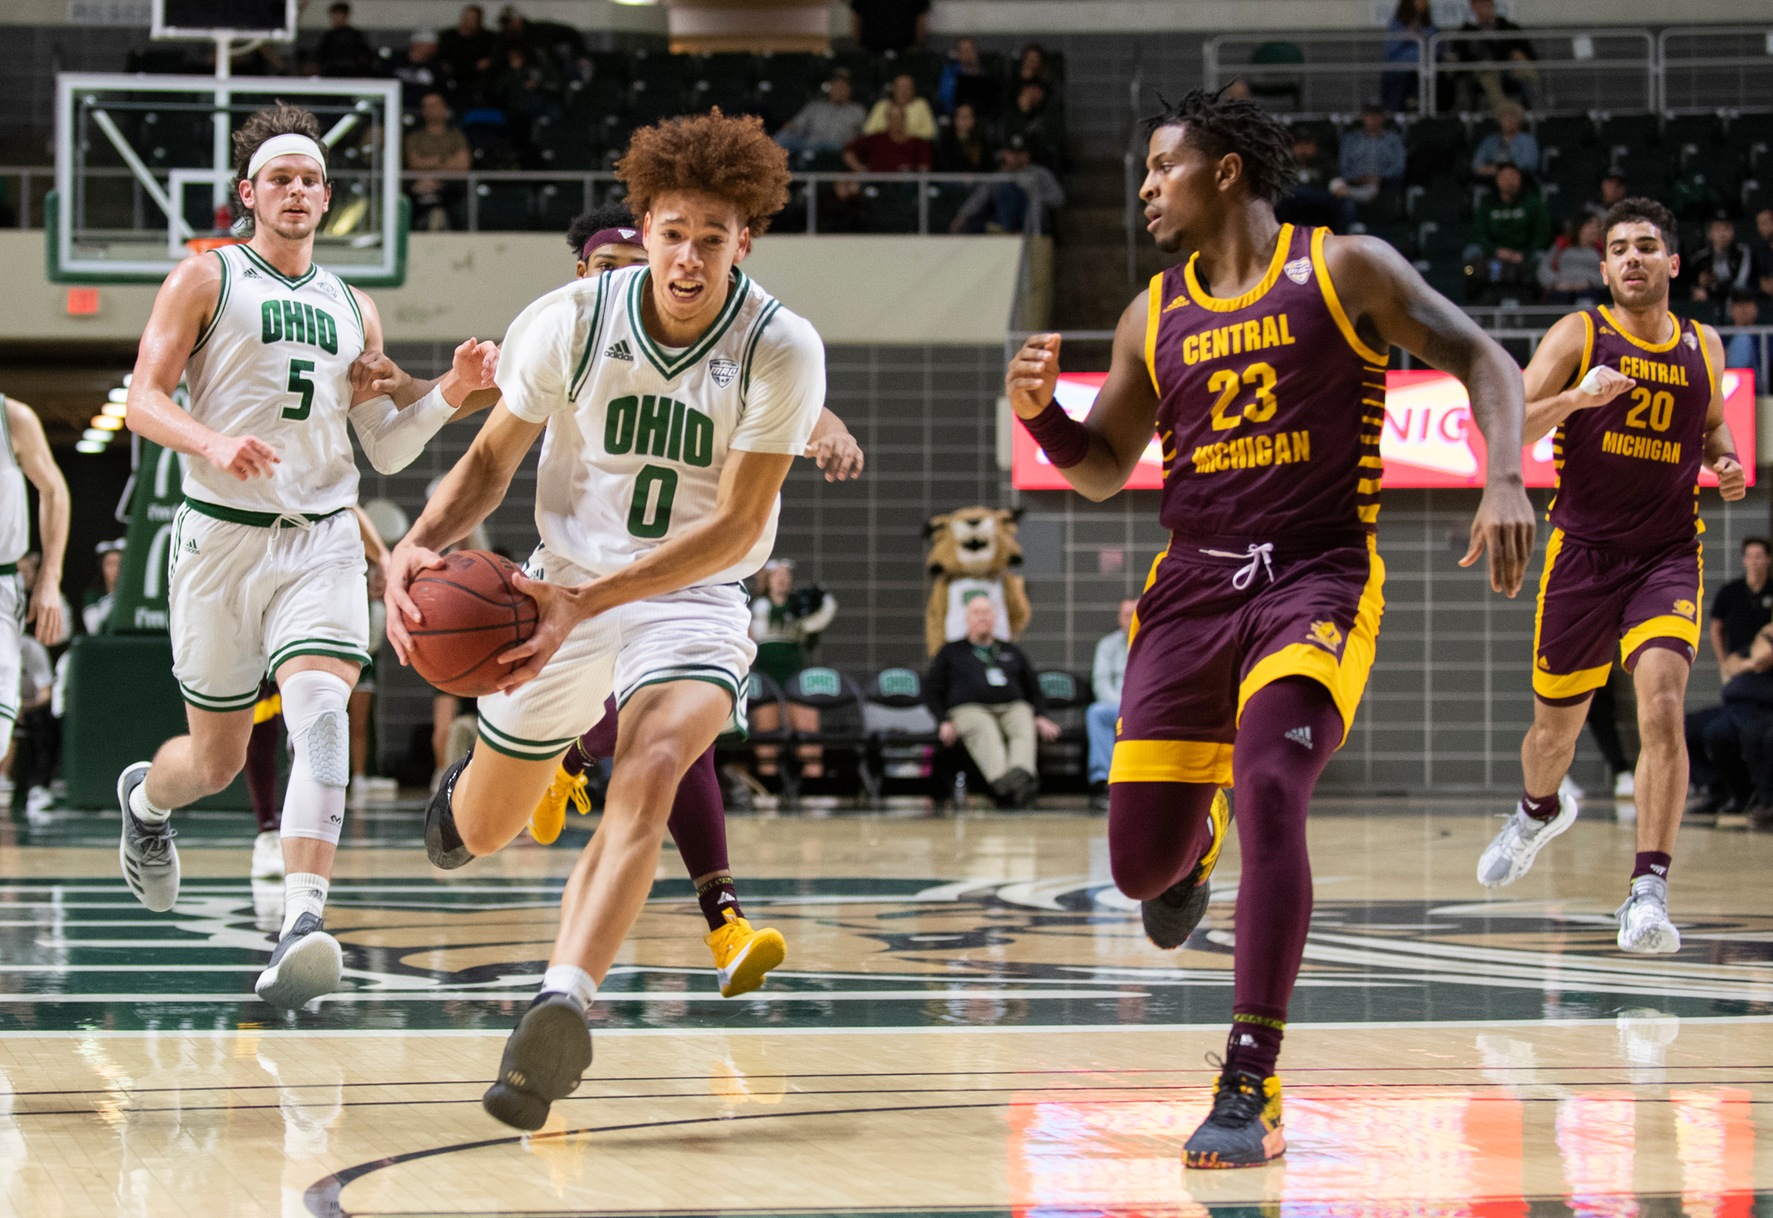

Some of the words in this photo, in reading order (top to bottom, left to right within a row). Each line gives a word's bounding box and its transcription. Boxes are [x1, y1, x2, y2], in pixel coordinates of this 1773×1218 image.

[261, 300, 338, 356] OHIO
[1183, 313, 1296, 366] CENTRAL
[604, 350, 634, 361] adidas
[1620, 355, 1690, 387] CENTRAL
[281, 358, 316, 421] 5
[1207, 361, 1278, 431] 23
[1625, 386, 1675, 432] 20
[604, 395, 714, 467] OHIO
[1191, 430, 1311, 474] MICHIGAN
[1601, 430, 1682, 465] MICHIGAN
[627, 464, 678, 539] 0
